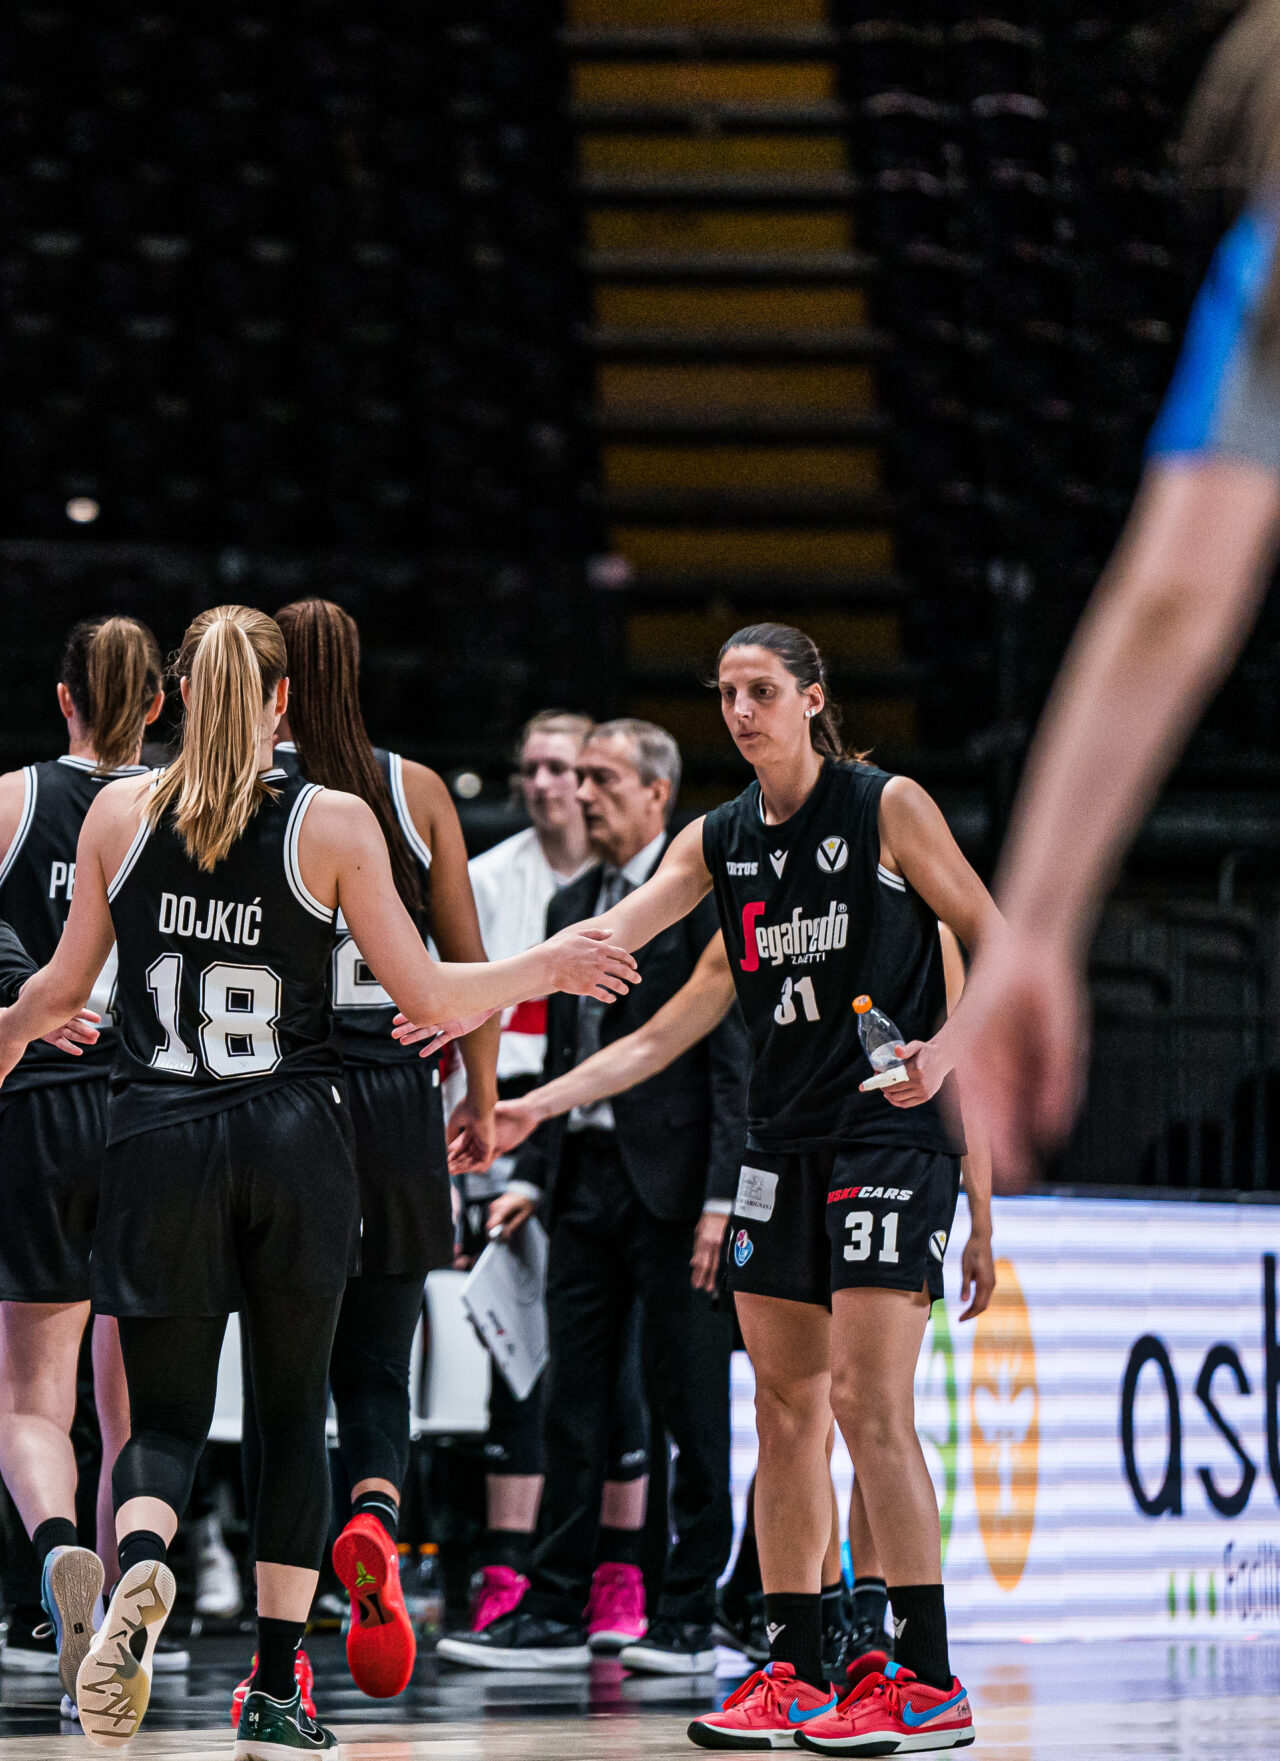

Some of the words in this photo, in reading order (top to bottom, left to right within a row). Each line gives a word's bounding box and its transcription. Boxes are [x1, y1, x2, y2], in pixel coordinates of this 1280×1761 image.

[159, 892, 262, 945] DOJKIĆ
[791, 952, 826, 965] ZAETTI
[146, 952, 283, 1080] 18
[773, 976, 821, 1026] 31
[843, 1210, 900, 1264] 31
